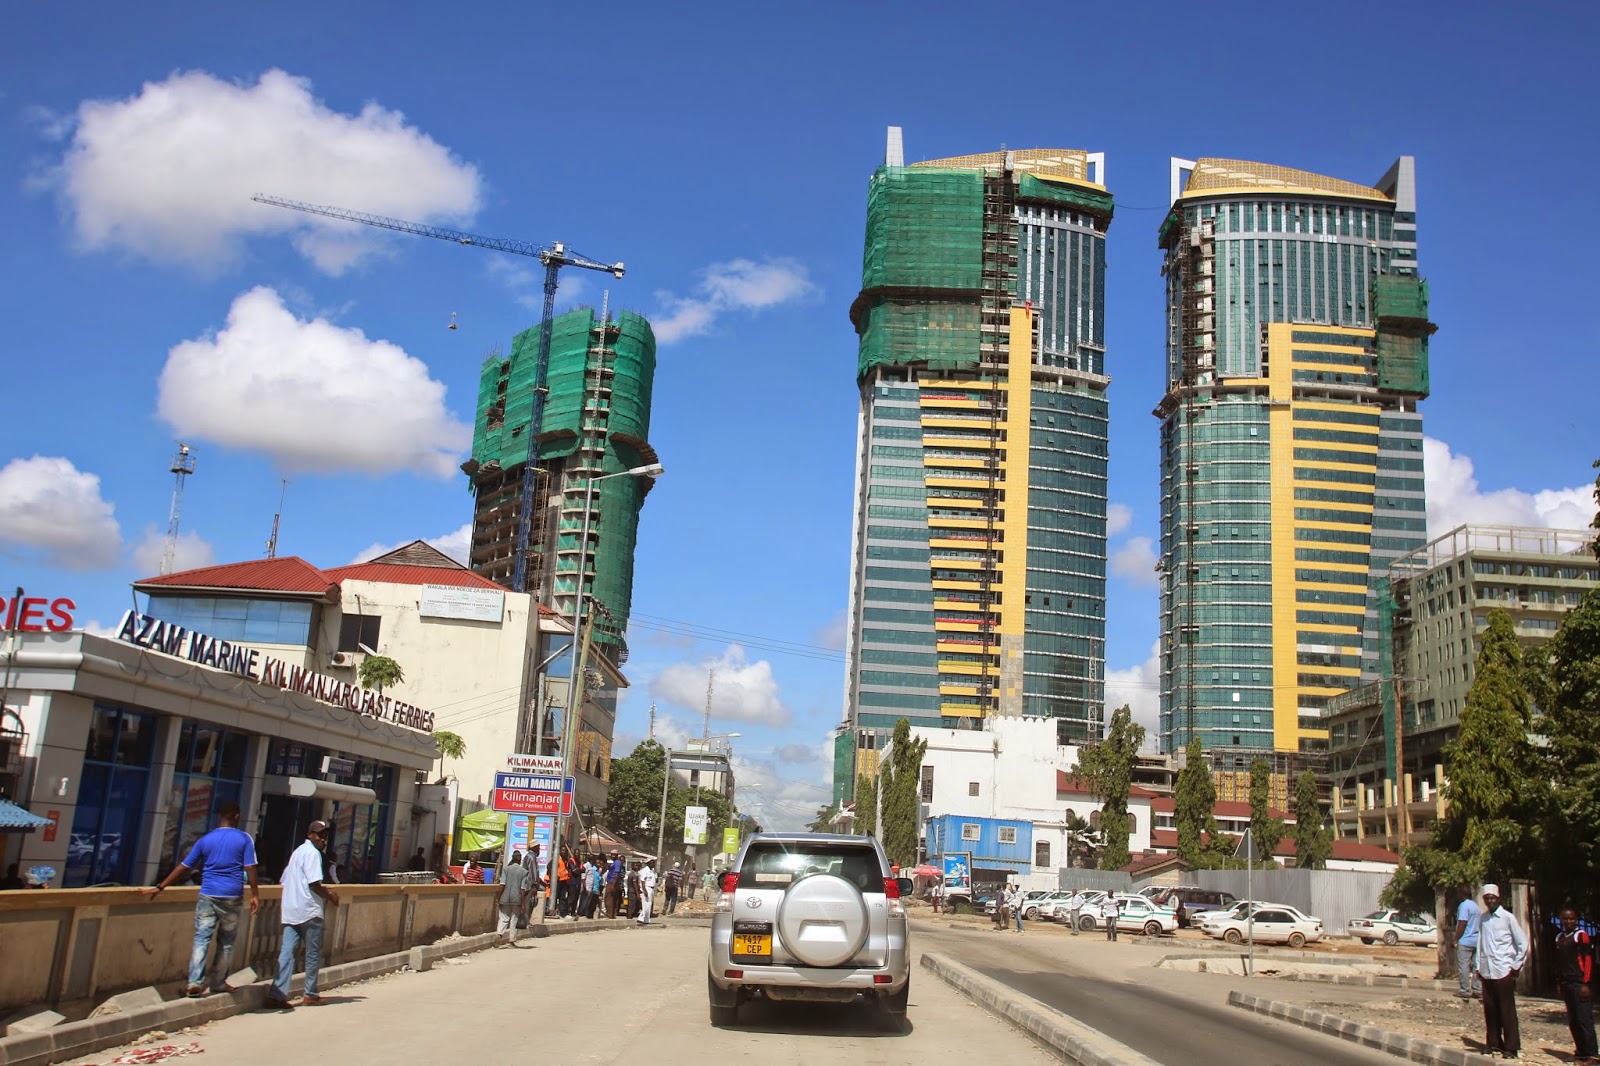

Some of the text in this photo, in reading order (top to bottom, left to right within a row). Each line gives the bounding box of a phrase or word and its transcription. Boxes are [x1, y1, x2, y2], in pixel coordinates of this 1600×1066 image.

[0, 597, 76, 632] IES
[116, 609, 435, 732] AZAM MARINE KILIMANJARO FAST FERRIES
[503, 777, 561, 790] AZAM MARIN
[743, 935, 762, 944] T417
[746, 944, 762, 954] CEP
